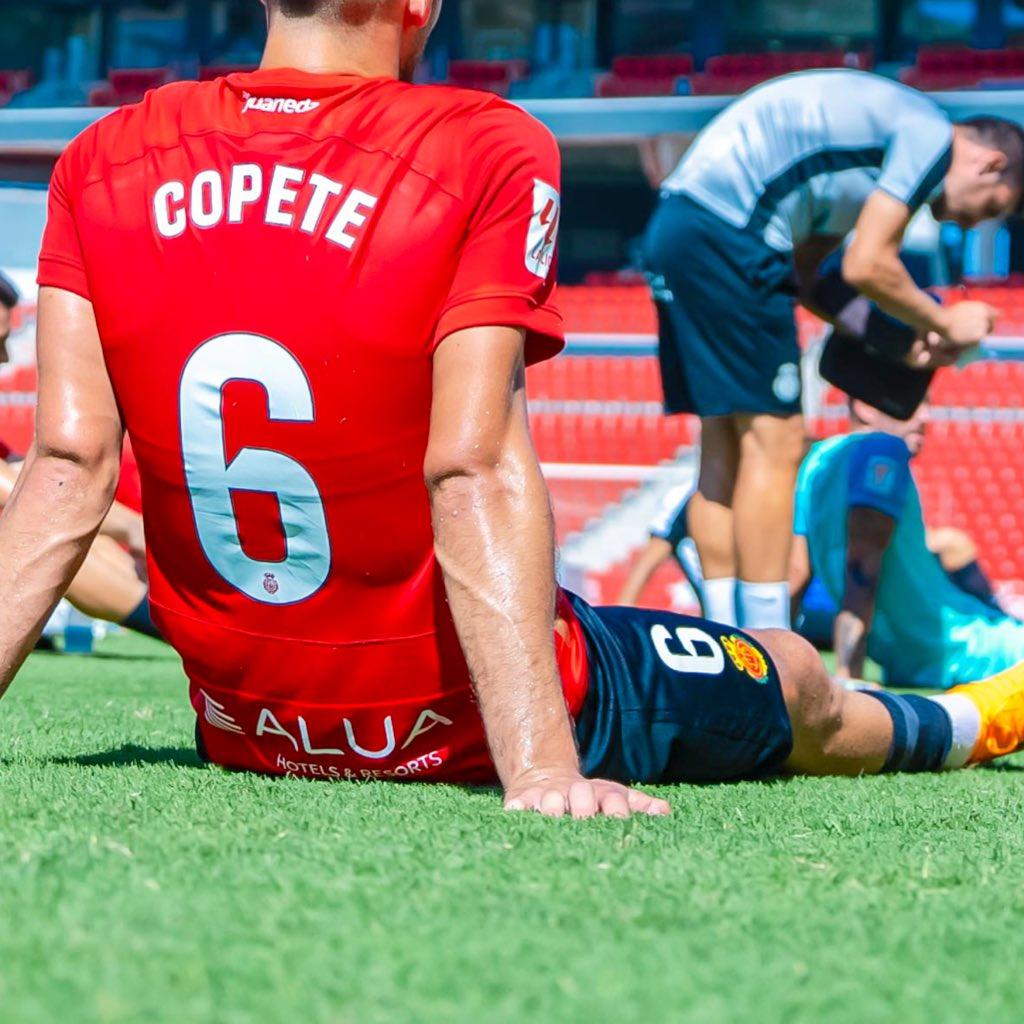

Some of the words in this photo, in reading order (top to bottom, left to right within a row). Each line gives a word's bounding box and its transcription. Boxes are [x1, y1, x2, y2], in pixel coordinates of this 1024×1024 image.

[153, 162, 378, 250] COPETE
[178, 330, 332, 606] 6
[255, 708, 453, 759] ALUA
[276, 753, 341, 778] HOTELS
